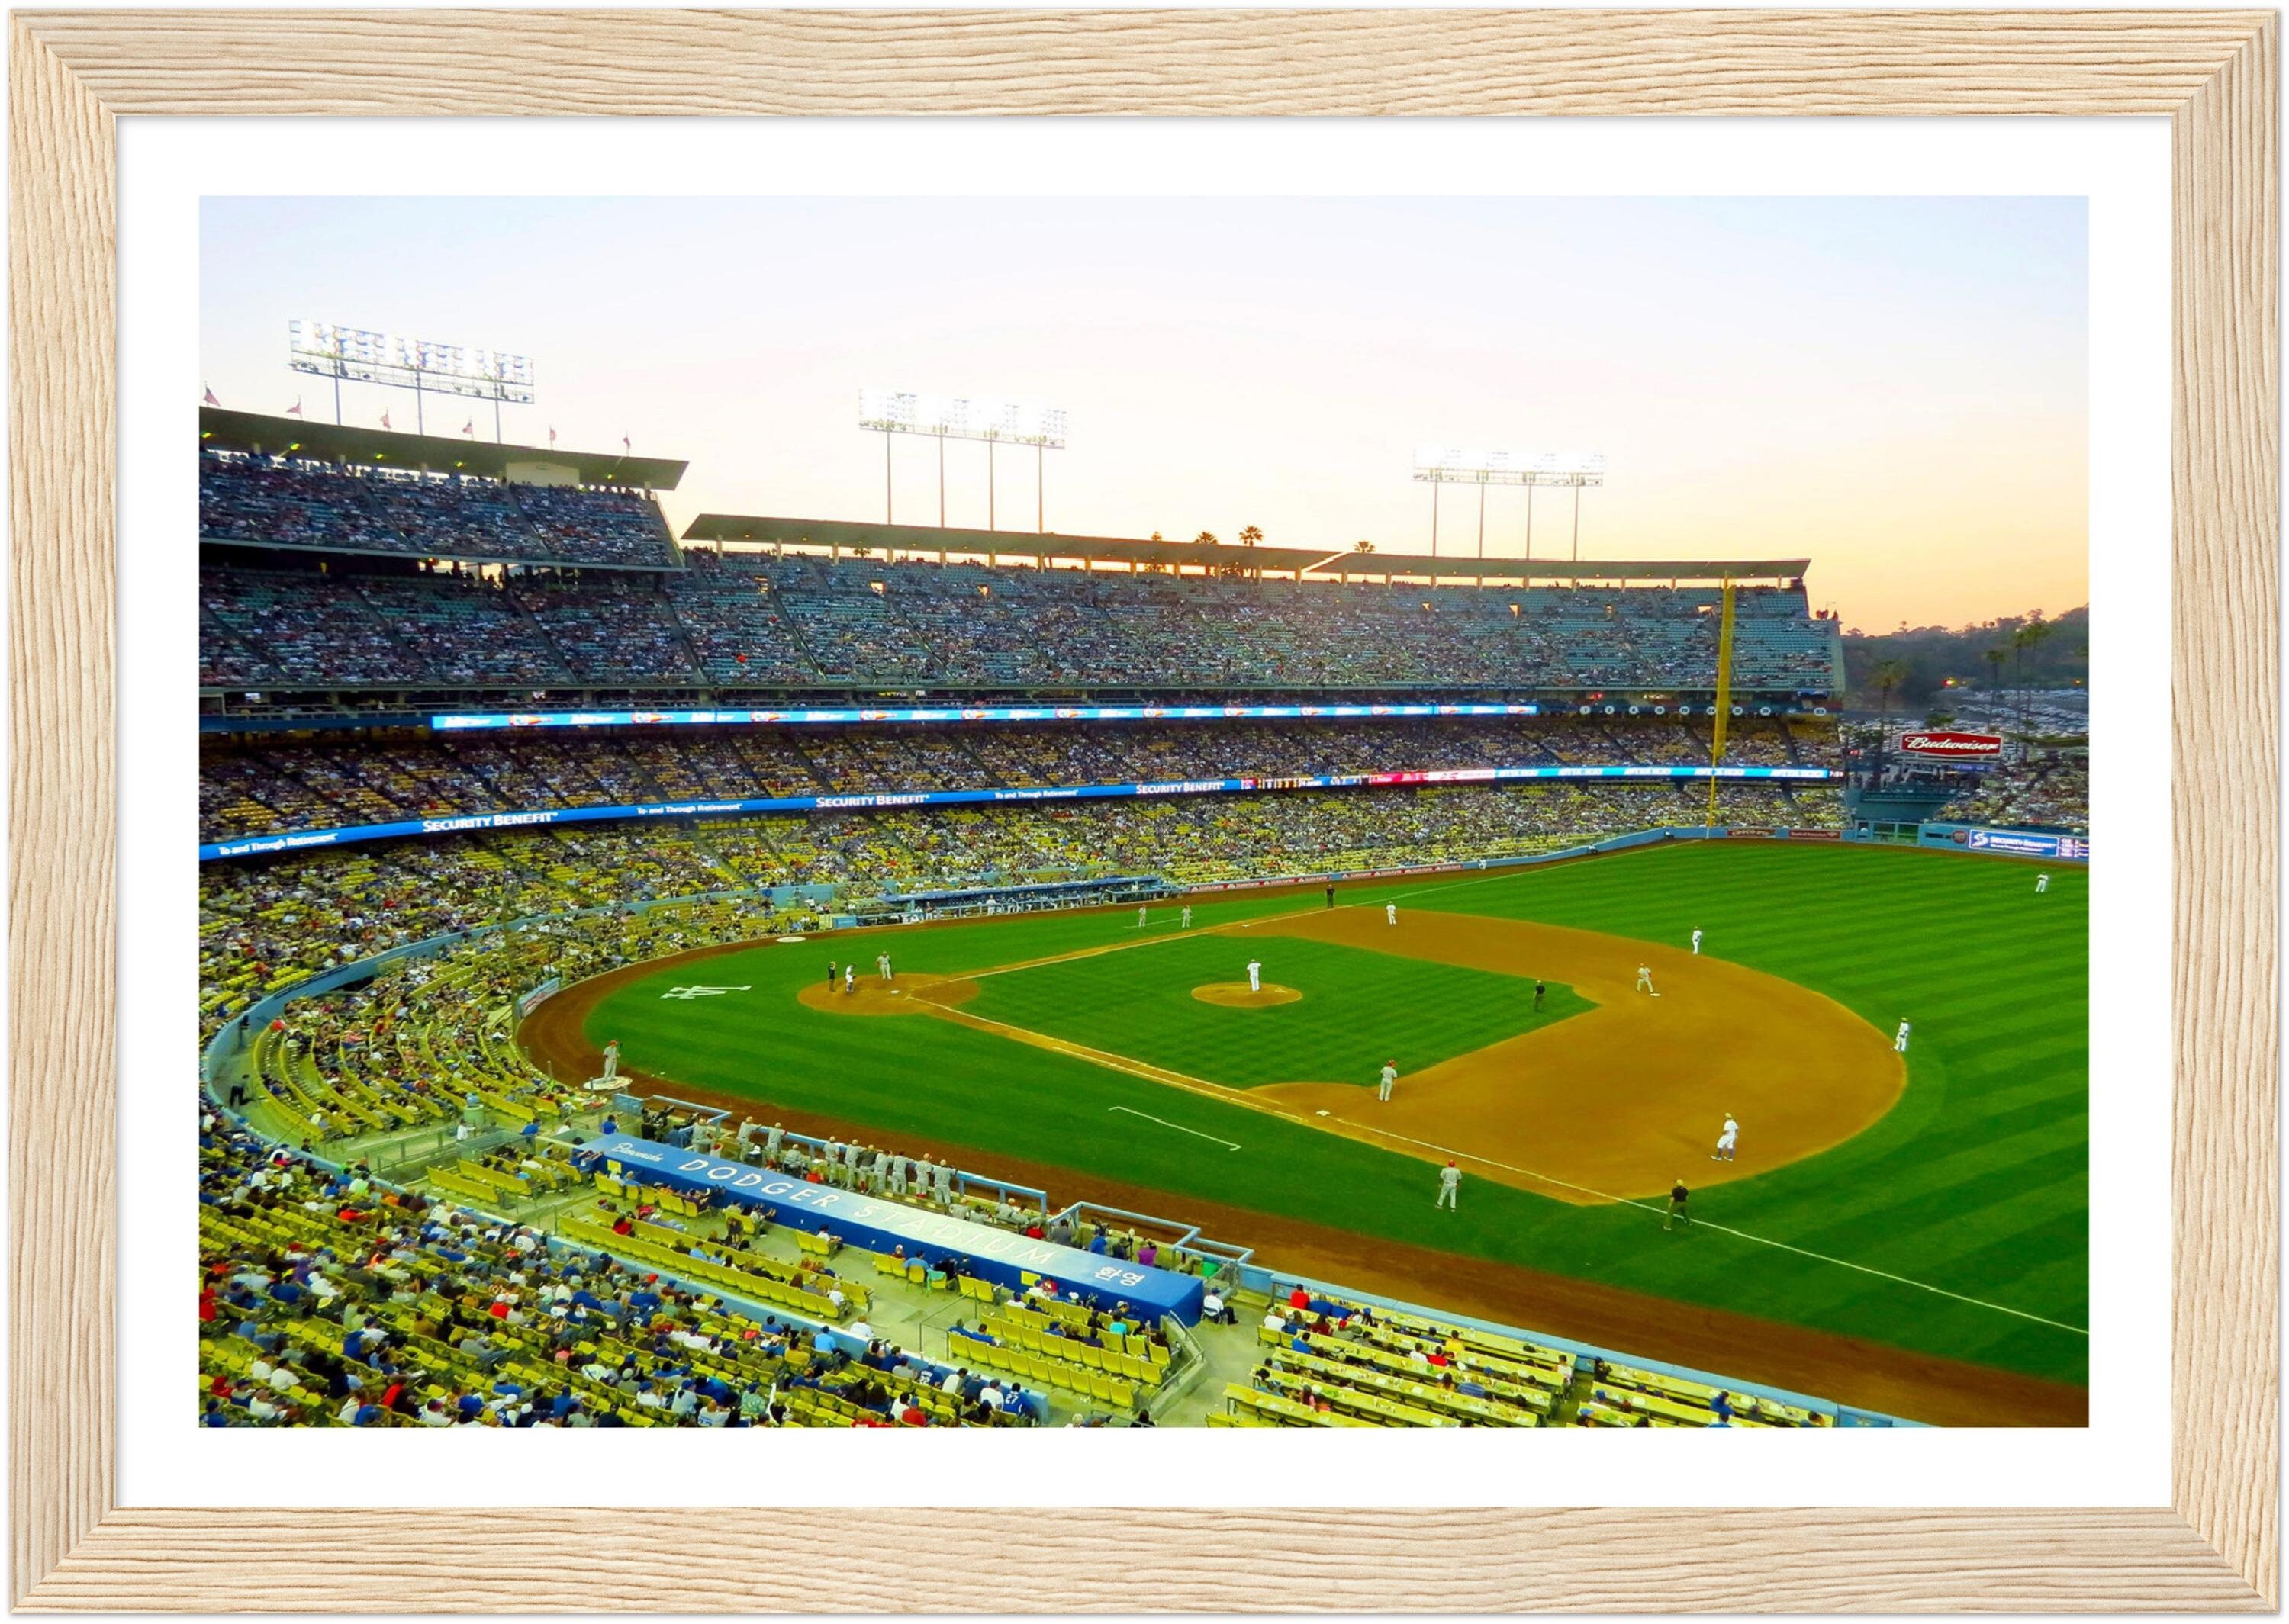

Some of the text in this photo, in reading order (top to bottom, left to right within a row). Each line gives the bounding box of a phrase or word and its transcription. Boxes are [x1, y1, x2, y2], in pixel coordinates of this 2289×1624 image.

[1904, 737, 1998, 750] Budweiser
[1136, 782, 1222, 794] SECURITY BENEFIT
[816, 794, 925, 808] SECURITY BENEFIT
[423, 812, 553, 833] SECURITY BENEFIT
[678, 1159, 1059, 1266] DODGER STADIUM
[1005, 1393, 1019, 1404] 27
